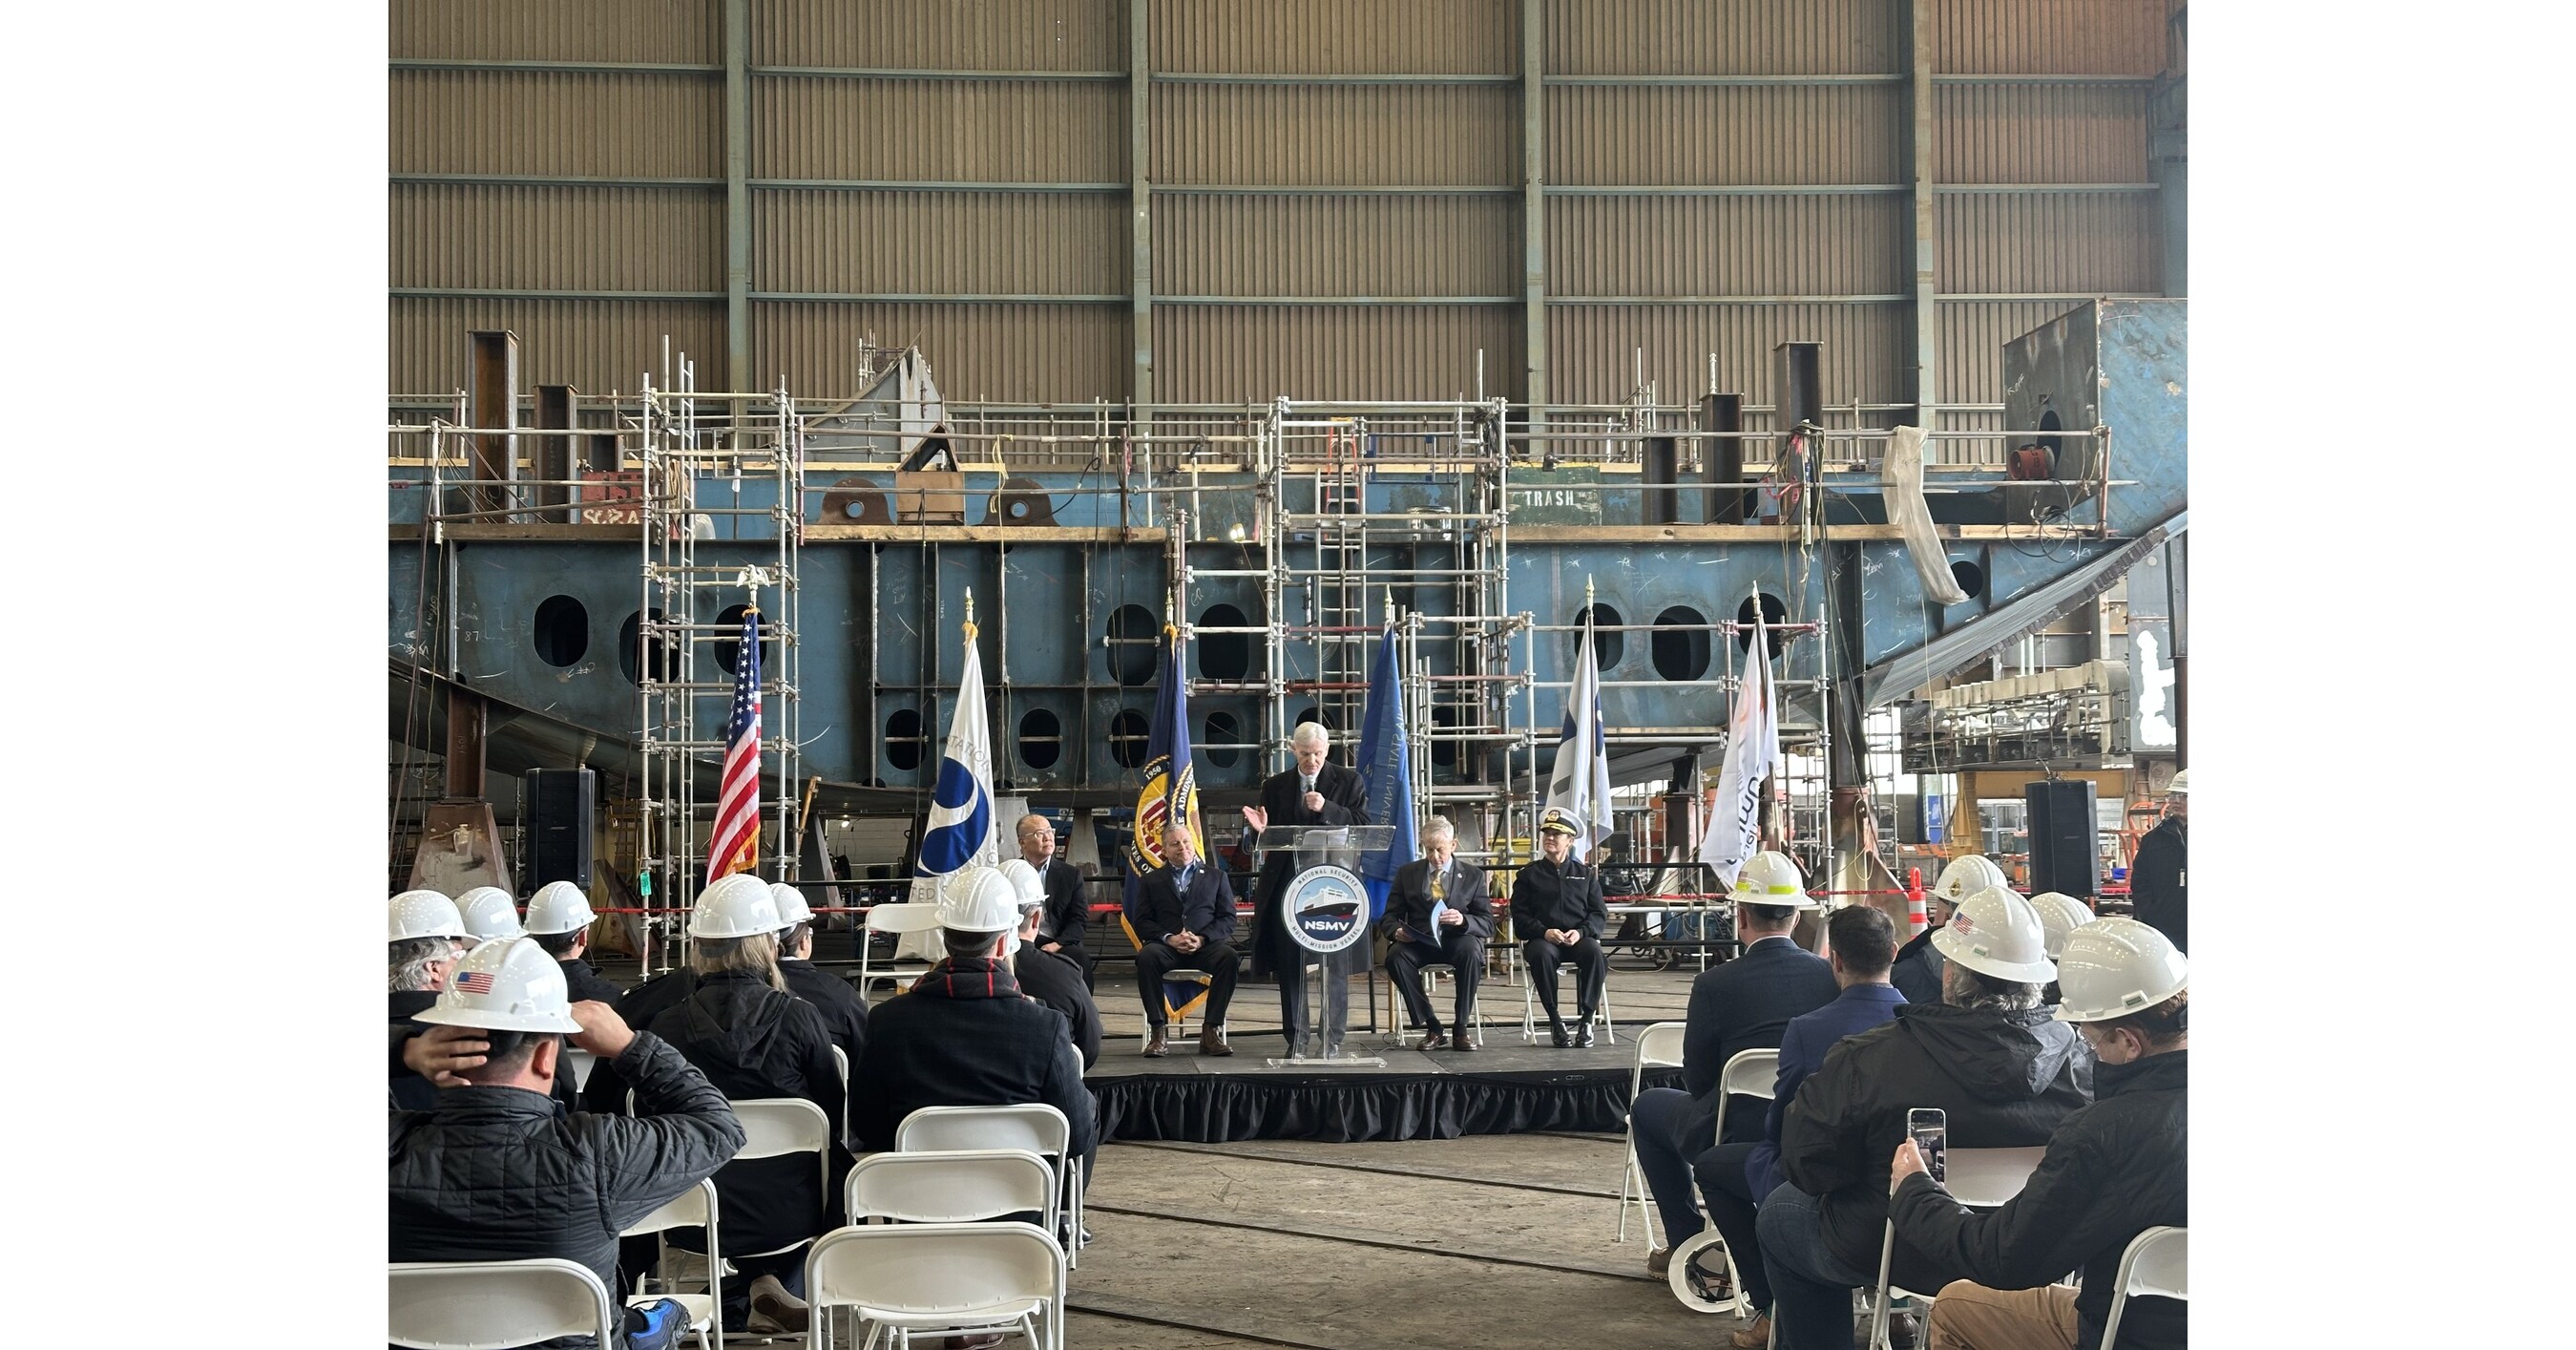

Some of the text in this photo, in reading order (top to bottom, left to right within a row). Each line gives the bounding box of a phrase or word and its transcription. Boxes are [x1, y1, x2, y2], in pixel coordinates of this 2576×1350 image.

[1525, 490, 1574, 506] TRASH
[1145, 765, 1162, 780] 1950
[1298, 869, 1358, 887] NATIONAL SECURITY
[1305, 920, 1350, 931] NSMV
[1292, 926, 1361, 950] MULTI-MISSION VESSEL
